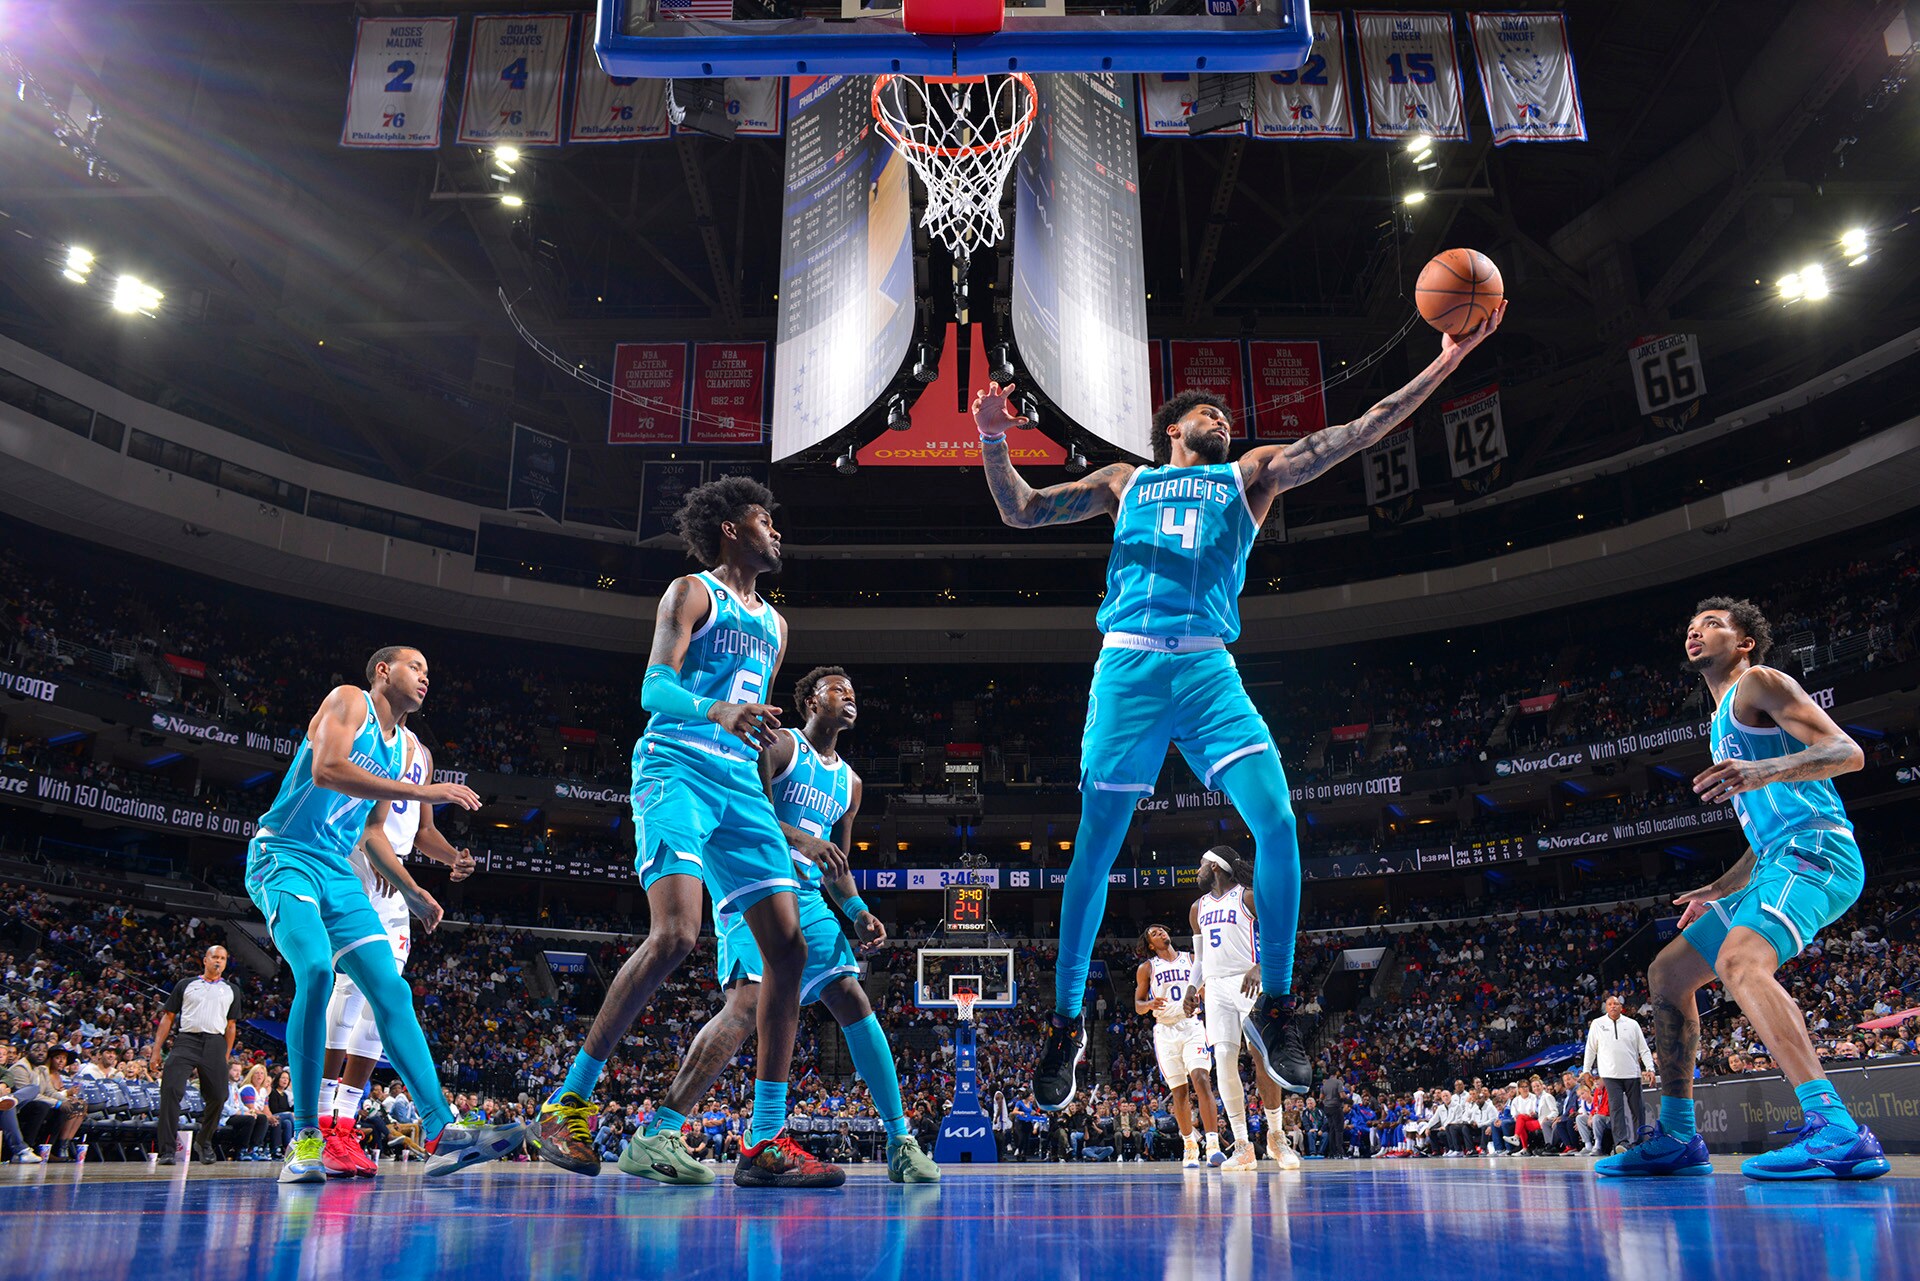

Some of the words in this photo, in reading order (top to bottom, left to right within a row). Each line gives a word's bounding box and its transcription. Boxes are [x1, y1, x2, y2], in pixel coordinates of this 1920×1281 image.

[1212, 4, 1232, 14] NBA
[390, 26, 423, 37] MOSES
[506, 24, 537, 35] DOLPH
[1501, 21, 1529, 31] DAVID
[499, 35, 542, 46] SCHAYES
[1391, 31, 1421, 41] GREER
[386, 37, 423, 48] MALONE
[500, 57, 528, 91] 4
[1386, 53, 1437, 85] 15
[384, 60, 416, 93] 2
[610, 106, 633, 121] 76
[1289, 105, 1313, 120] 76
[1404, 103, 1427, 119] 76
[1516, 103, 1541, 119] 76
[382, 112, 406, 128] 76
[500, 110, 523, 126] 76
[580, 125, 634, 134] Philadelphia
[1263, 124, 1319, 133] Philadelphia
[1494, 123, 1547, 134] Philadelphia
[352, 132, 406, 141] Philadelphia
[408, 132, 431, 141] 76ers
[790, 177, 807, 192] TEAM
[789, 228, 801, 240] 3PT
[642, 351, 659, 360] NBA
[721, 350, 738, 359] NBA
[1198, 348, 1214, 357] NBA
[1276, 349, 1292, 357] NBA
[1637, 342, 1657, 360] JAKE
[632, 360, 668, 369] EASTERN
[712, 359, 747, 368] EASTERN
[1190, 357, 1225, 366] EASTERN
[1268, 358, 1302, 367] EASTERN
[625, 369, 673, 379] CONFERENCE
[705, 369, 753, 379] CONFERENCE
[1184, 368, 1232, 376] CONFERENCE
[1262, 368, 1311, 377] CONFERENCE
[1642, 347, 1697, 408] 66
[626, 379, 671, 389] CHAMPIONS
[706, 379, 751, 389] CHAMPIONS
[1186, 376, 1231, 386] CHAMPIONS
[1265, 377, 1309, 386] CHAMPIONS
[638, 417, 655, 430] 76
[1281, 415, 1299, 427] 76
[1444, 411, 1460, 425] TOM
[532, 435, 553, 449] 1985
[926, 441, 982, 449] ENTER
[1454, 413, 1499, 468] 42
[875, 449, 958, 458] FARGO
[964, 449, 1049, 458] WES
[662, 465, 685, 475] 2016
[729, 466, 752, 474] 2018
[1372, 446, 1409, 499] 35
[529, 470, 550, 484] NCAA
[1138, 478, 1229, 505] HORNETS
[1161, 507, 1199, 550] 4
[166, 717, 239, 744] NovaCare
[246, 732, 271, 750] With
[273, 738, 292, 756] 150
[1511, 752, 1582, 774] NovaCare
[1589, 741, 1615, 760] With
[1617, 736, 1637, 754] 150
[1639, 723, 1697, 750] locations,
[433, 768, 469, 786] corner
[1305, 786, 1315, 800] is
[1317, 785, 1331, 798] on
[1333, 782, 1363, 797] every
[1365, 776, 1402, 794] corner
[568, 785, 631, 804] NovaCare
[1175, 793, 1200, 808] With
[1202, 792, 1222, 807] 150
[38, 775, 71, 797] With
[74, 784, 98, 808] 150
[100, 790, 168, 824] locations,
[171, 808, 204, 830] care
[206, 811, 219, 832] is
[222, 817, 240, 835] on
[782, 781, 845, 824] HORNETS
[1549, 831, 1609, 849] NovaCare
[1613, 824, 1635, 840] With
[1636, 821, 1652, 835] 150
[1653, 814, 1700, 833] locations,
[1701, 808, 1723, 823] care
[1725, 806, 1734, 820] is
[1421, 855, 1438, 863] 8:38
[1438, 853, 1450, 861] PM
[1456, 850, 1469, 858] PHI
[1456, 858, 1472, 866] CHA
[1503, 852, 1510, 860] 11
[877, 871, 897, 888] 62
[913, 875, 925, 885] 24
[979, 875, 995, 884] 3RD
[1009, 871, 1030, 888] 66
[1143, 877, 1149, 886] 2
[1159, 876, 1166, 885] 5
[959, 888, 983, 901] 3:40
[953, 900, 980, 921] 24
[1200, 909, 1237, 927] PHILA
[1209, 928, 1222, 948] 5
[570, 964, 585, 973] 108
[1346, 961, 1361, 969] 106
[1170, 985, 1182, 1001] 0
[1740, 1102, 1764, 1124] The
[1766, 1100, 1801, 1124] Power
[1849, 1092, 1879, 1118] sical
[1879, 1092, 1920, 1118] Ther
